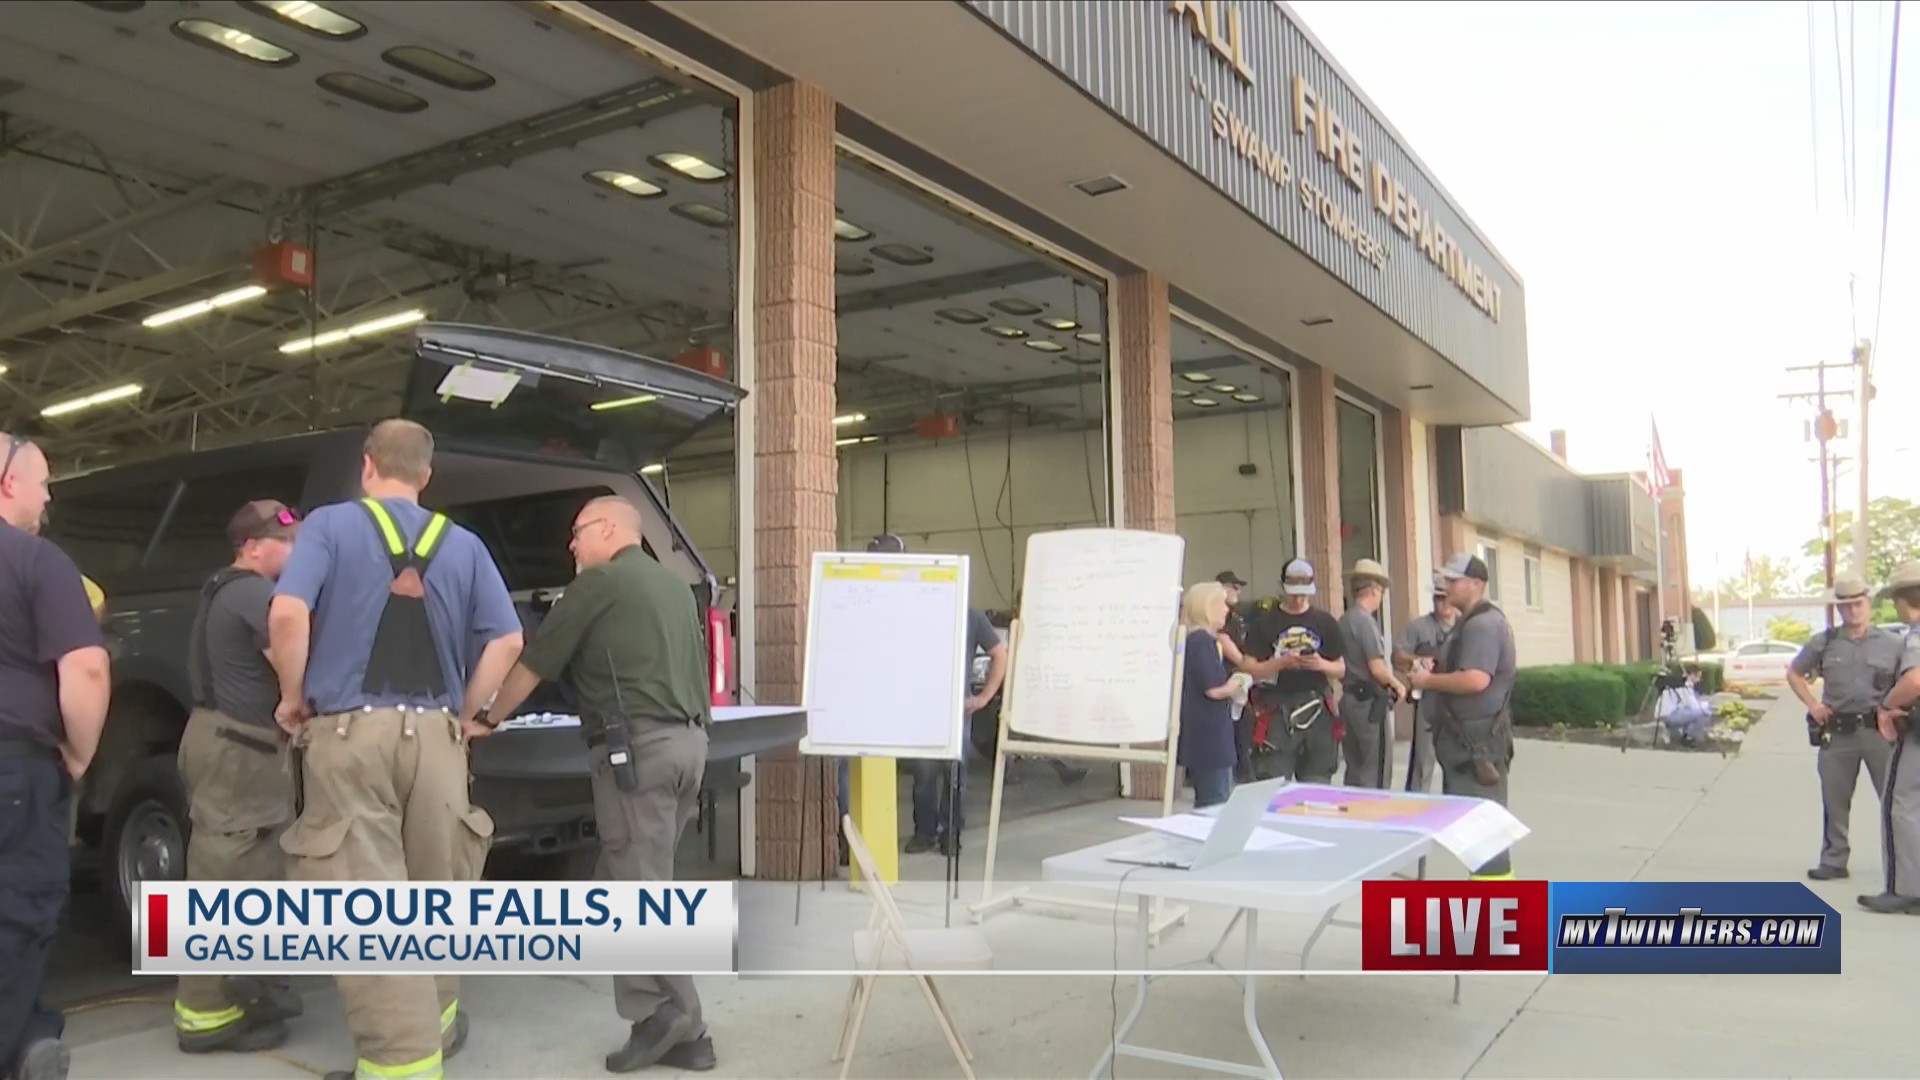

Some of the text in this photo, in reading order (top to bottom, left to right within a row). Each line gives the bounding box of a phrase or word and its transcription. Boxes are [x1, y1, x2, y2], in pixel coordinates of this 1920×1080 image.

[1172, 0, 1501, 324] LL FIRE DEPARTMENT
